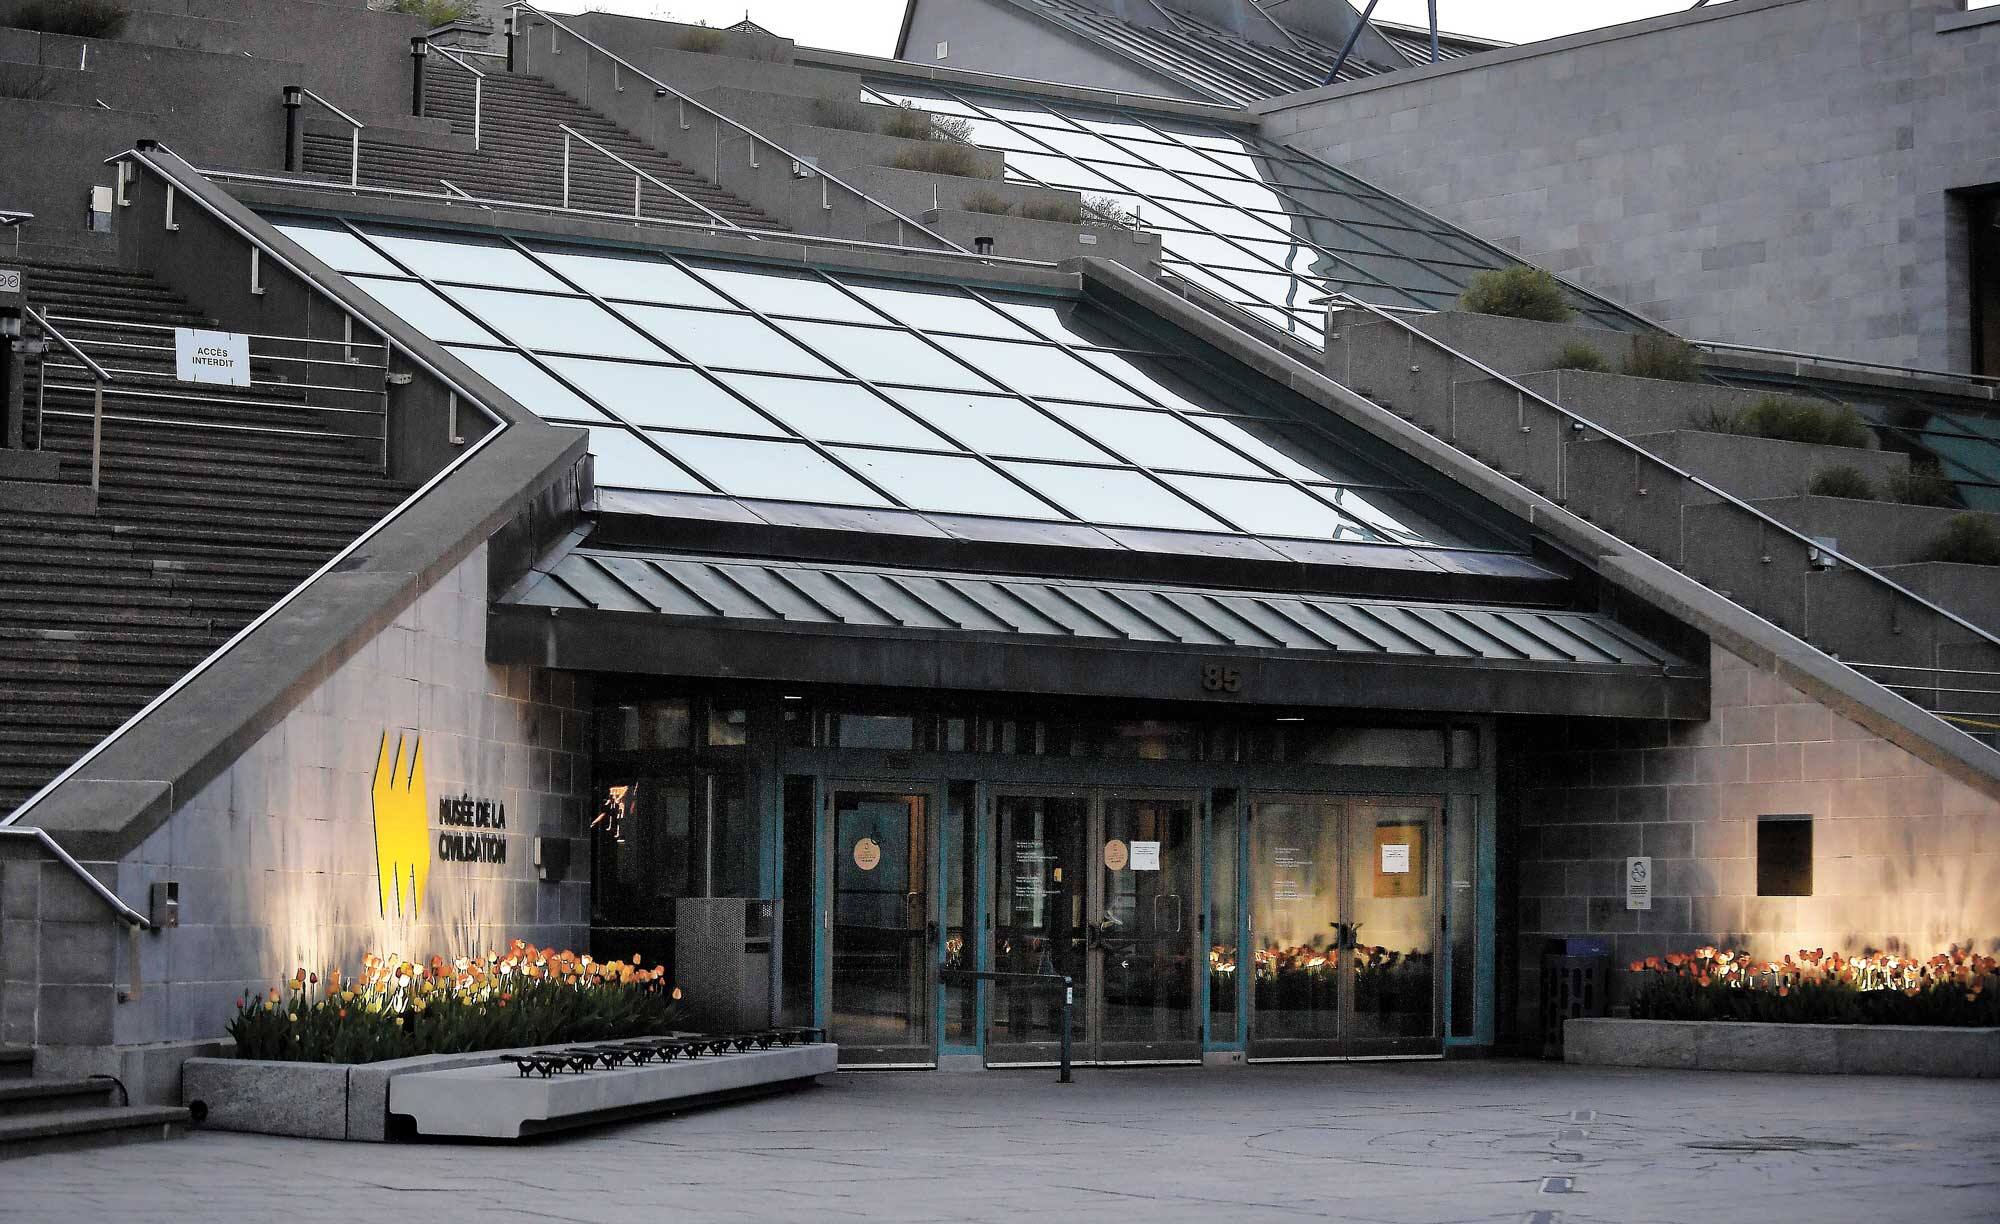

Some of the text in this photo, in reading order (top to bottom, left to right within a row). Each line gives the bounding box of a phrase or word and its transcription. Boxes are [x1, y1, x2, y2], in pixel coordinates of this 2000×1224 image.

[192, 356, 234, 368] INTERDIT
[197, 347, 228, 357] ACCÈS
[1202, 663, 1242, 692] 85
[439, 793, 506, 829] MUSÉE DE LA
[439, 833, 507, 864] CIVILISATION
